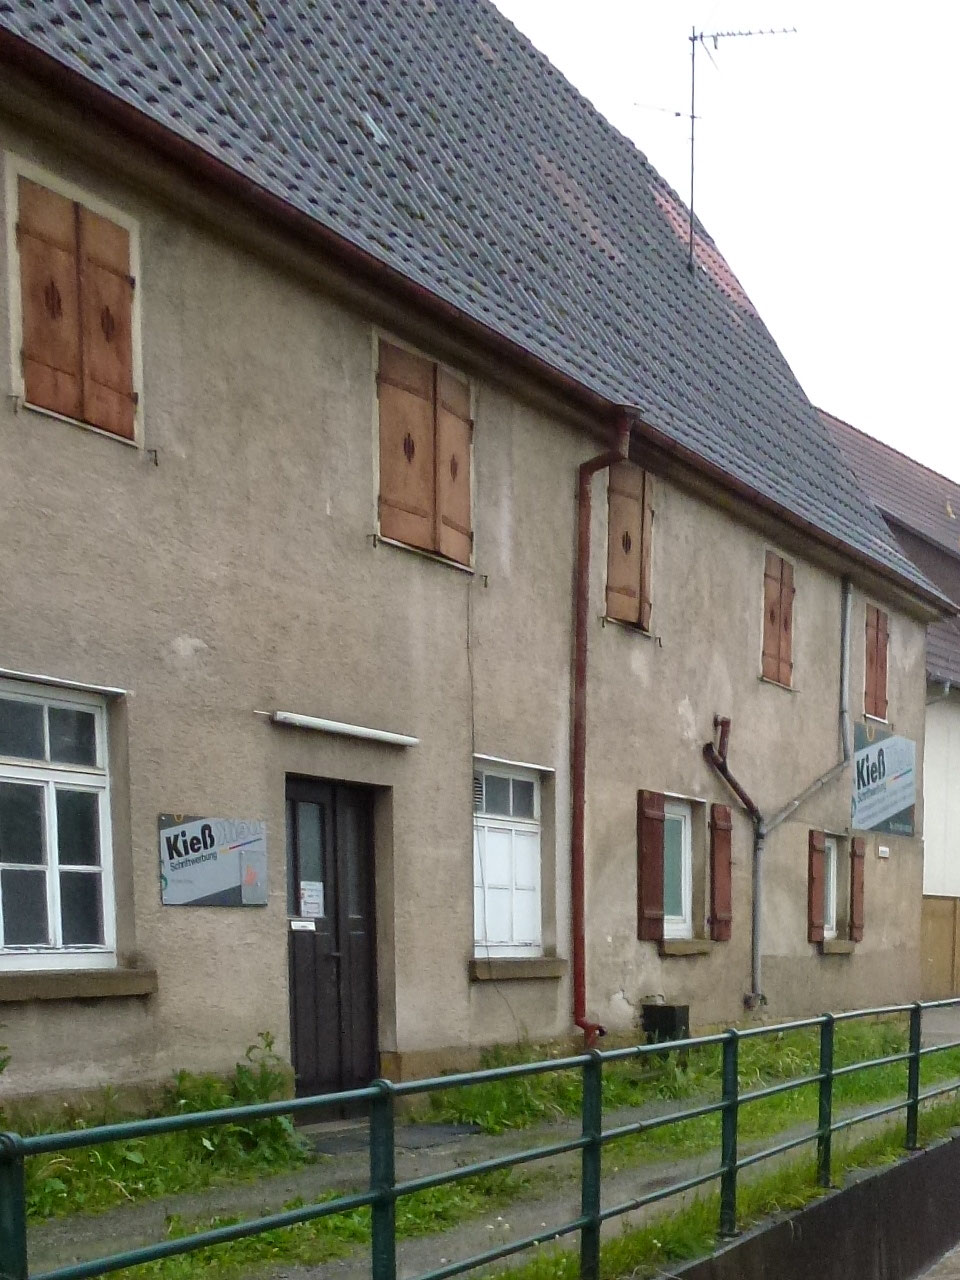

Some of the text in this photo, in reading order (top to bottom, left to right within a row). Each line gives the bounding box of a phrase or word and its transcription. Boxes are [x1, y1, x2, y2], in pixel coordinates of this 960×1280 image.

[856, 747, 885, 790] Kieß
[165, 823, 215, 860] Kieß
[170, 850, 218, 872] Schriftwerbung
